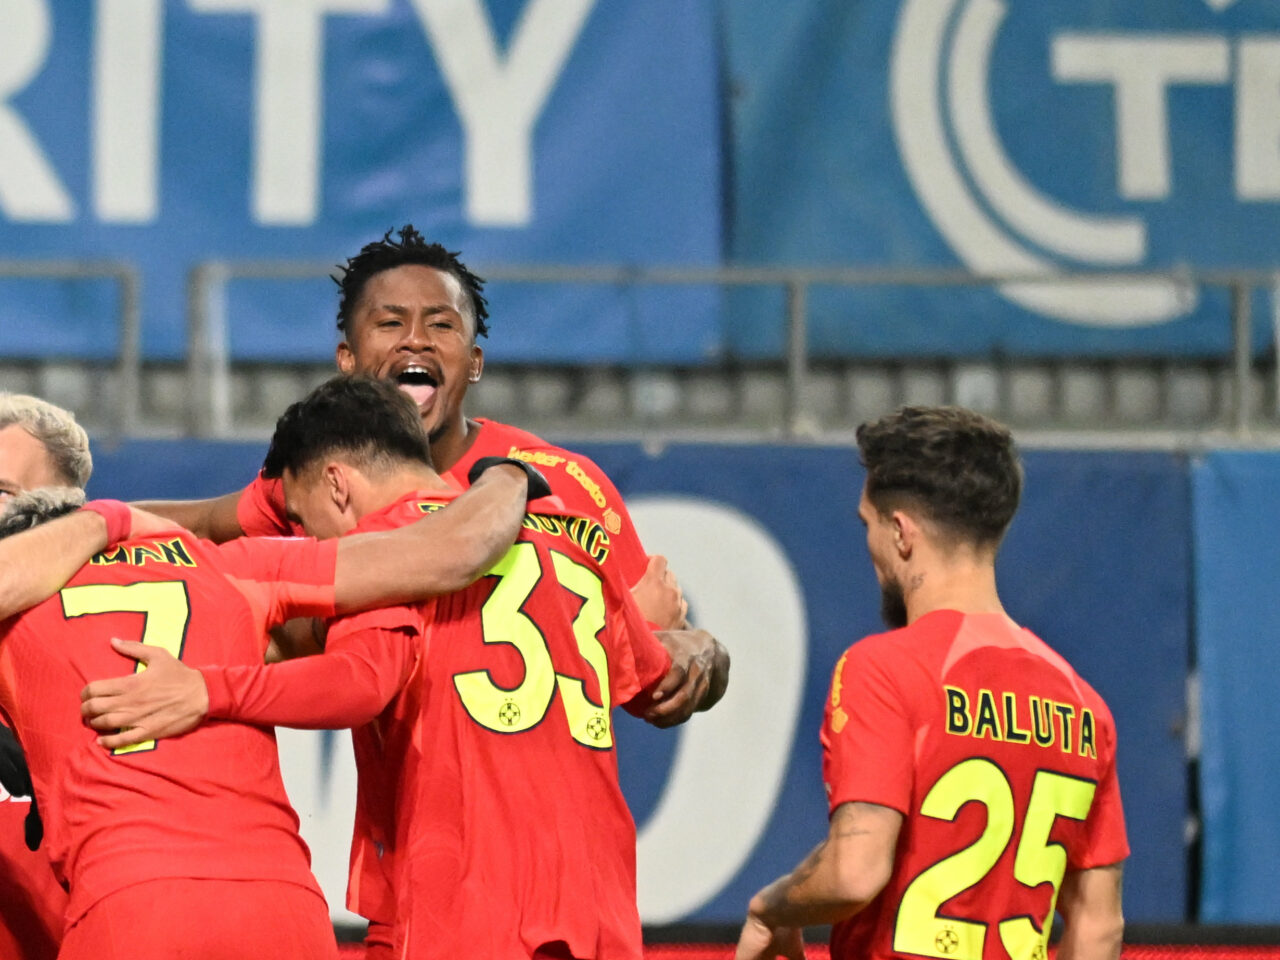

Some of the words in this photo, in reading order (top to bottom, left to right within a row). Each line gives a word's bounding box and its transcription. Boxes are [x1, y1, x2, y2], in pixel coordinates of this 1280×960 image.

[59, 579, 190, 756] 7
[453, 541, 613, 751] 33
[945, 685, 1098, 761] BALUTA
